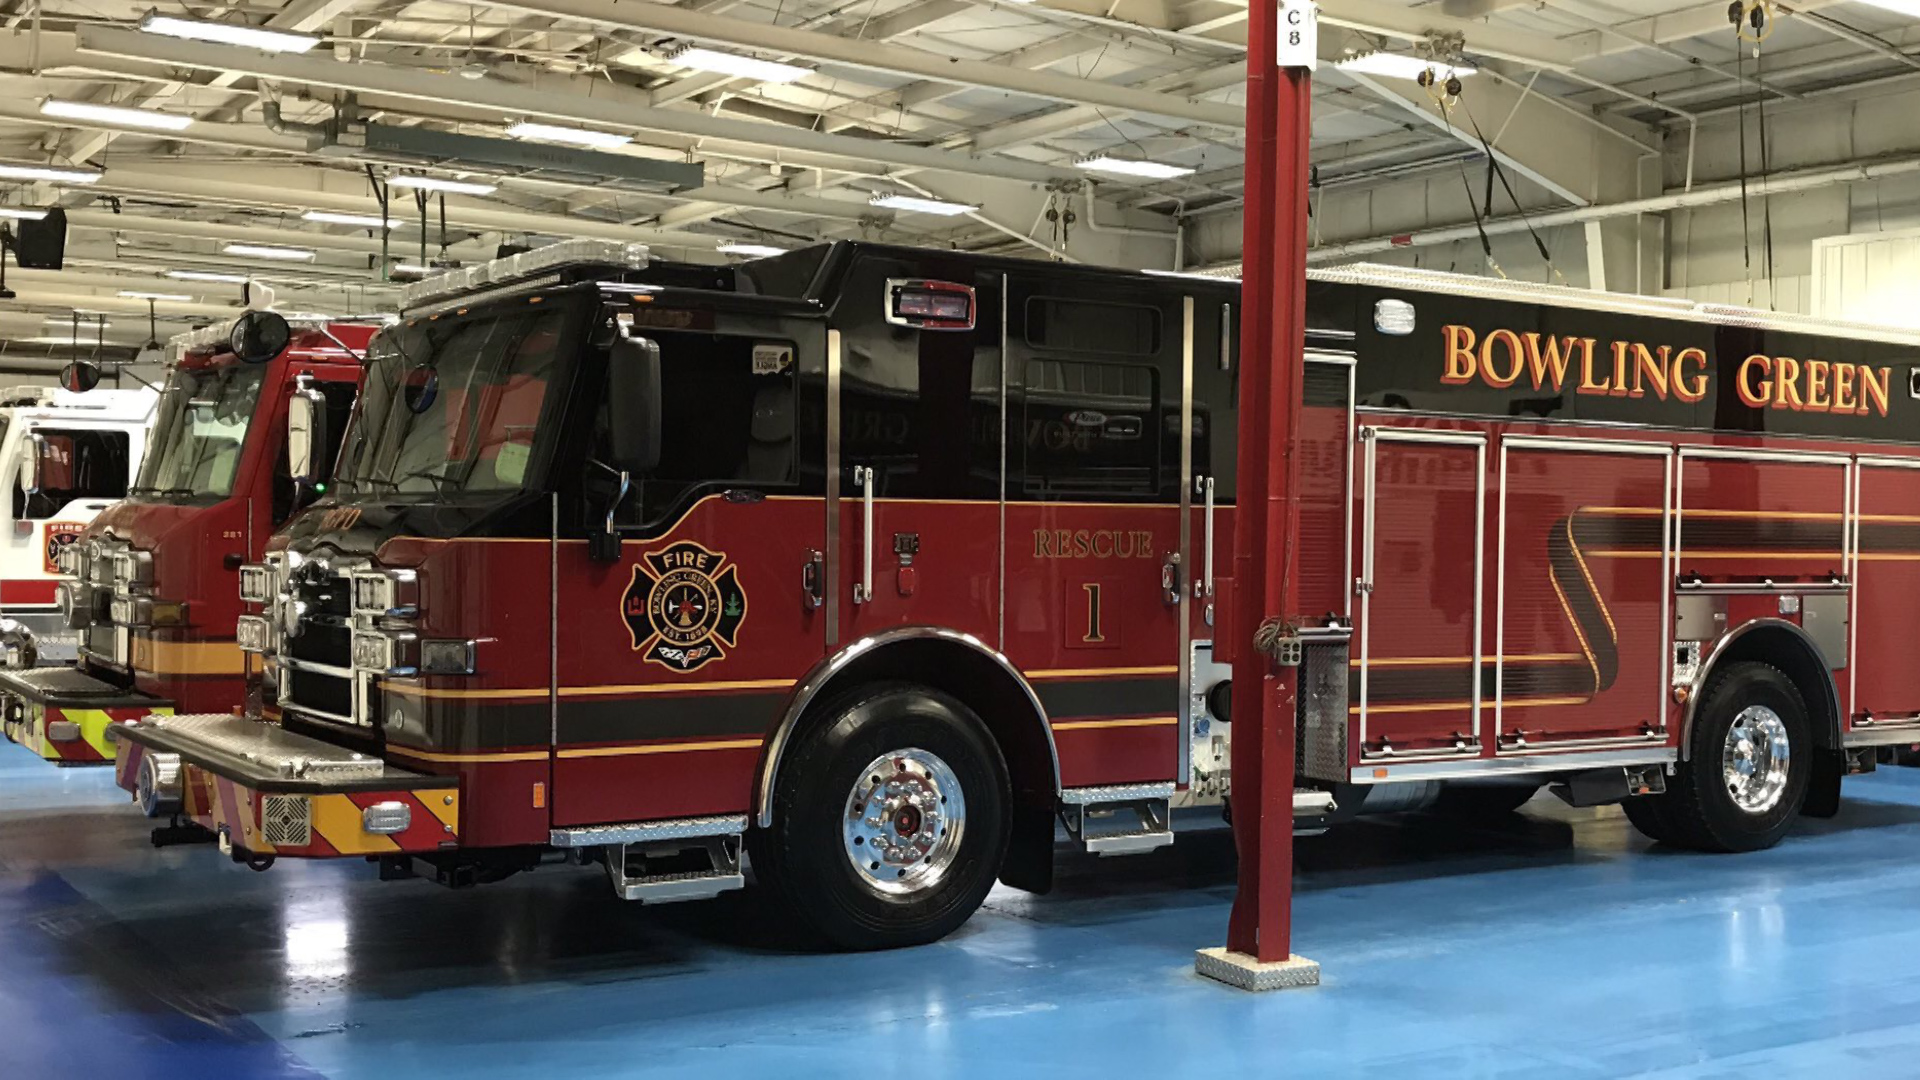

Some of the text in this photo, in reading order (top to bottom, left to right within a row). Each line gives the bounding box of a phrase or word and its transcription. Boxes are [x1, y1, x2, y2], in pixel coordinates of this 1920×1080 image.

[1287, 9, 1301, 26] C
[1289, 30, 1301, 46] 8
[1440, 324, 1892, 418] BOWLING GREEN
[1033, 529, 1153, 558] RESCUE
[662, 551, 710, 569] FIRE
[653, 573, 682, 615] BOWLING
[1082, 583, 1105, 642] 1
